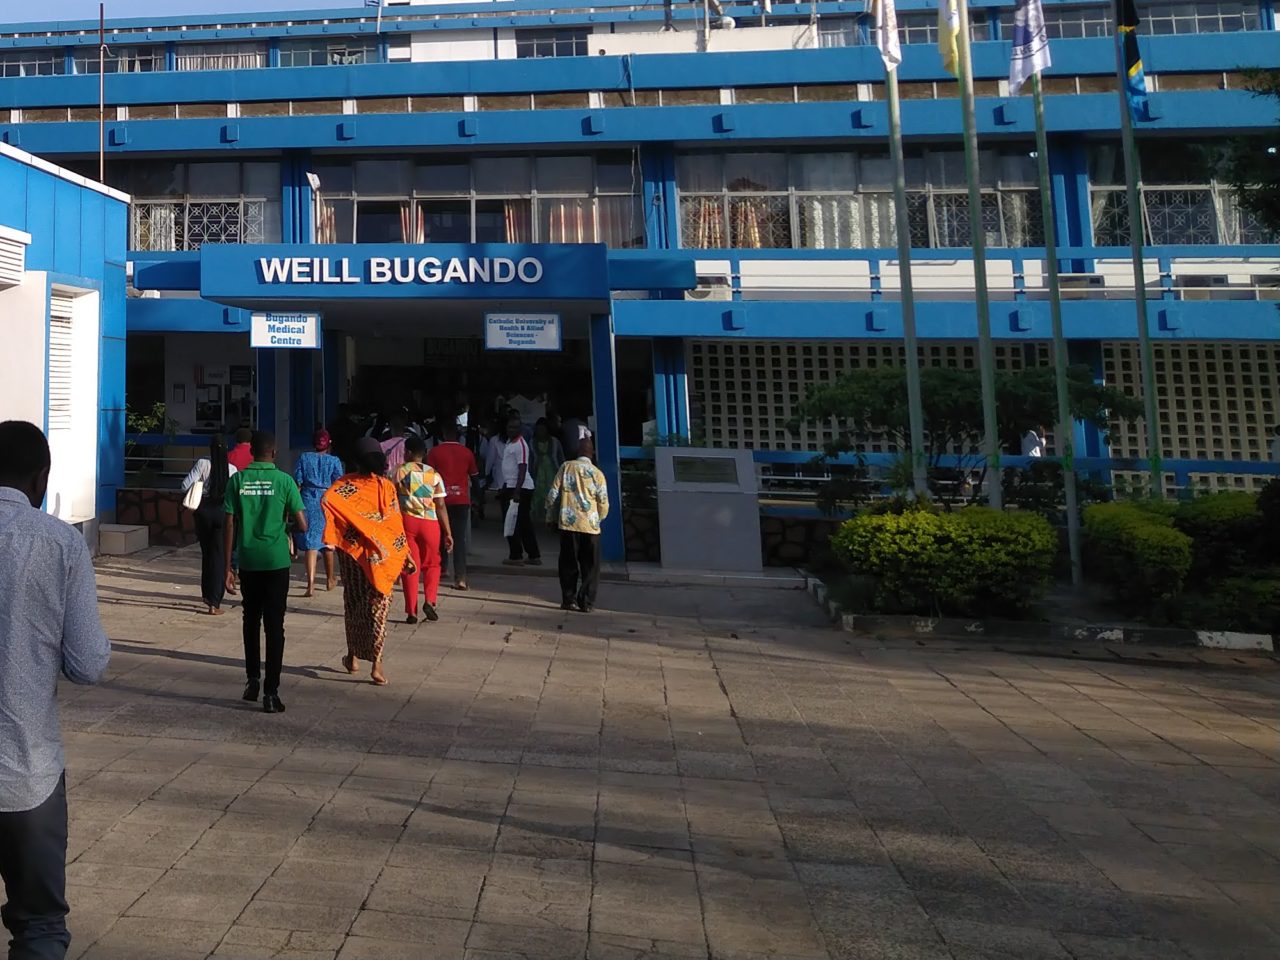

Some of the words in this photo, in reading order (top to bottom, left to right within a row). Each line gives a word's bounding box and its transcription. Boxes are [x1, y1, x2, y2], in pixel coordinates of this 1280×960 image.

[260, 256, 361, 283] WEILL
[370, 256, 543, 283] BUGANDO
[265, 312, 308, 324] Bugando
[267, 325, 305, 334] Medical
[270, 335, 302, 345] Centre
